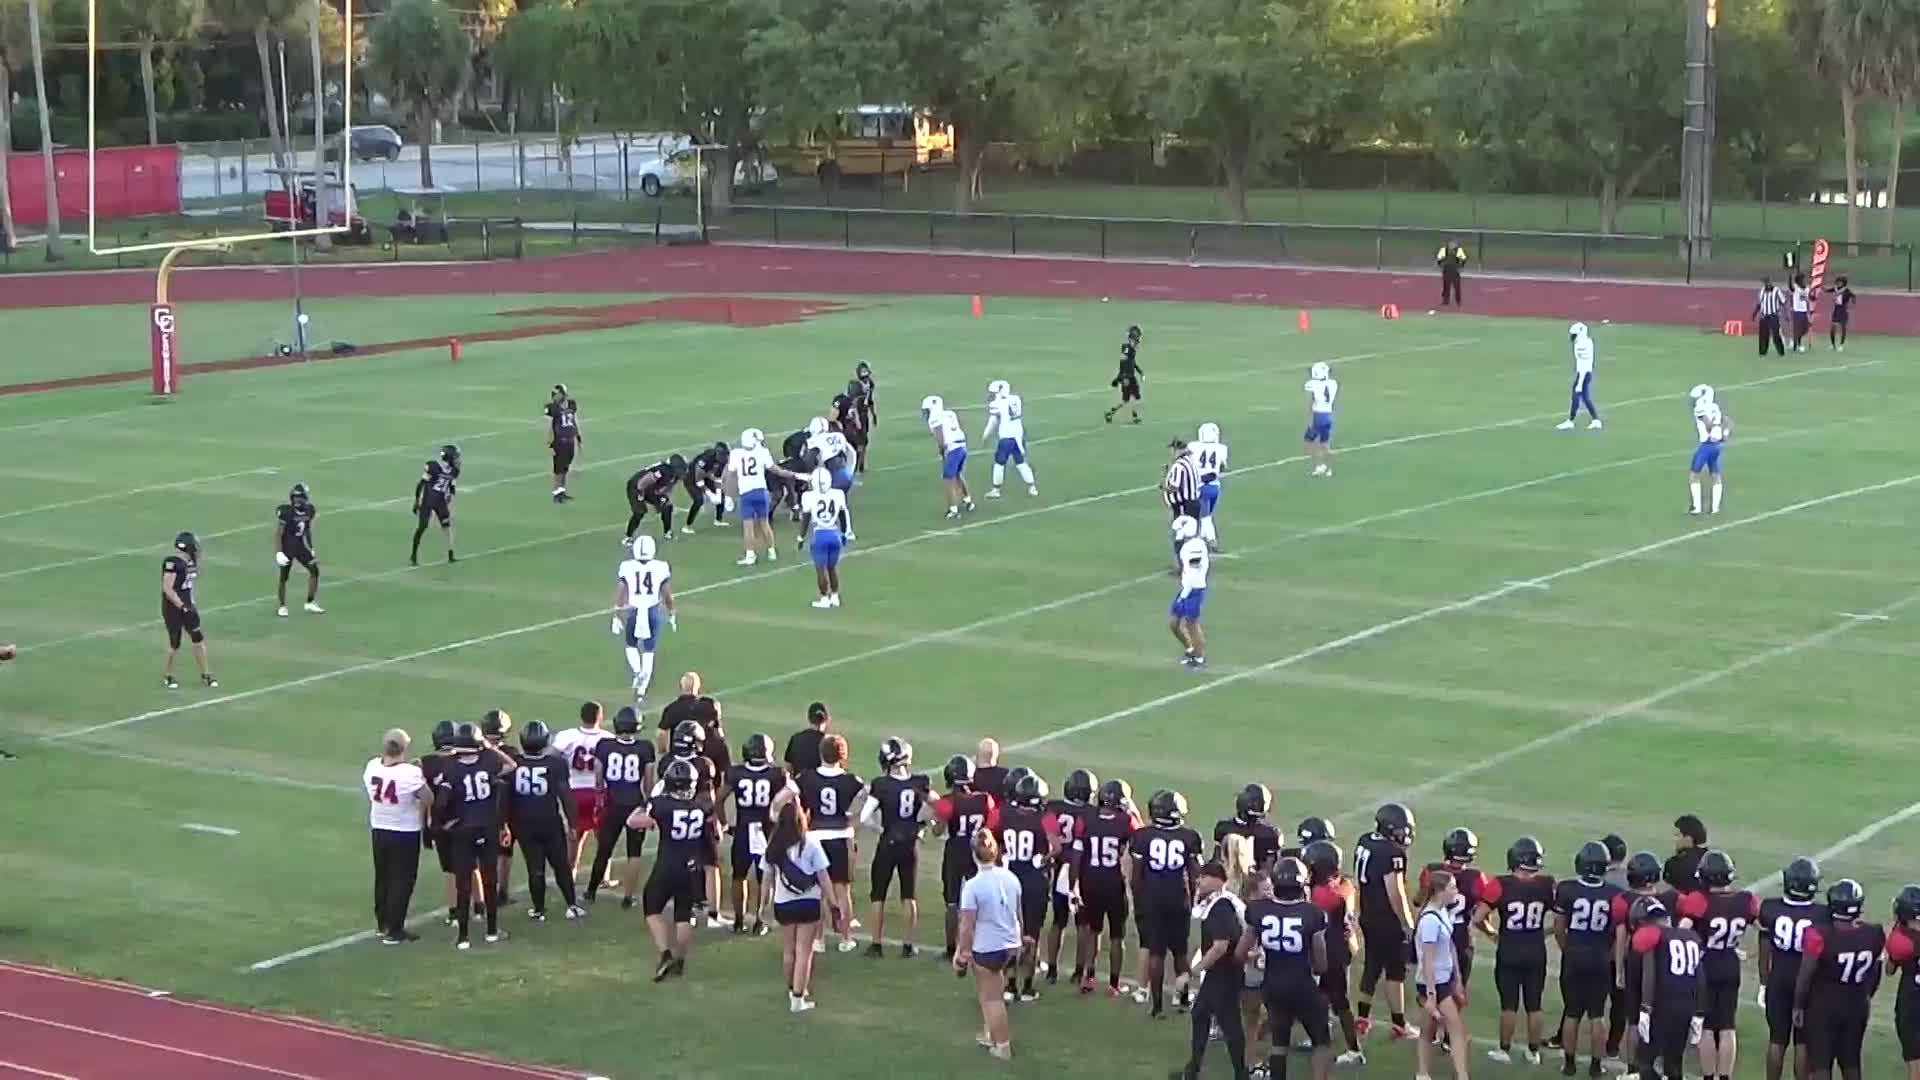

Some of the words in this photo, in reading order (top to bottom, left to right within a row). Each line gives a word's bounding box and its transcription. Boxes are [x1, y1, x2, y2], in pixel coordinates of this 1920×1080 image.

[741, 457, 758, 476] 12
[1200, 451, 1216, 469] 44
[817, 500, 836, 519] 24
[635, 571, 653, 595] 14
[515, 766, 548, 796] 65
[606, 752, 640, 782] 88
[371, 775, 399, 804] 74
[463, 770, 491, 802] 16
[738, 779, 771, 807] 38
[820, 787, 837, 815] 9
[900, 789, 915, 818] 8
[671, 809, 704, 840] 52
[957, 814, 984, 840] 17
[1090, 836, 1119, 868] 15
[1149, 839, 1185, 871] 96
[1506, 901, 1544, 929] 28
[1570, 898, 1610, 931] 26
[1261, 915, 1303, 953] 25
[1838, 951, 1873, 983] 72
